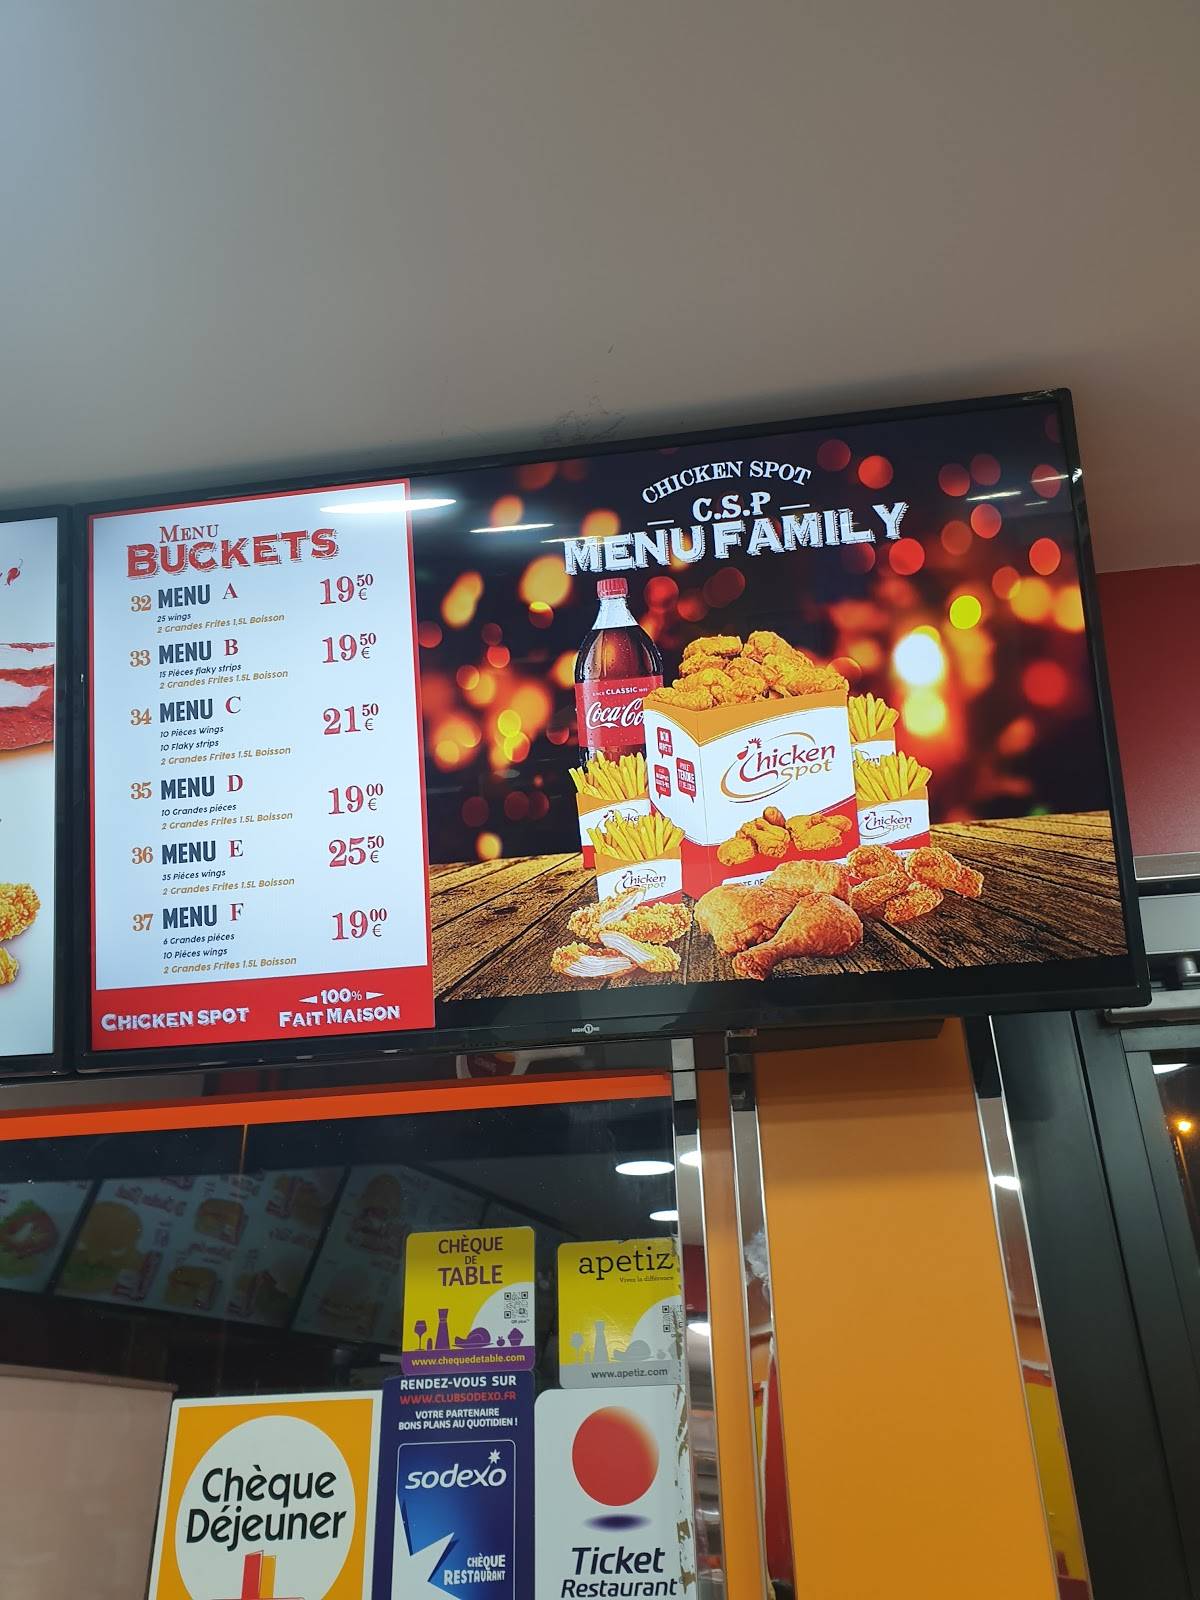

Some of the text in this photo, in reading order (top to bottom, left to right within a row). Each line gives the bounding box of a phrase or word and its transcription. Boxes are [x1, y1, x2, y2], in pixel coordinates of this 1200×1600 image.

[641, 460, 812, 504] CHICKEN SPOT
[692, 491, 771, 522] C.S.P
[563, 501, 909, 576] MENU FAMILY
[126, 528, 339, 580] BUCKETS
[131, 582, 238, 612] 32 MENU A
[156, 613, 191, 623] 25 wings
[165, 622, 203, 633] Grandes
[205, 618, 230, 628] Frites
[250, 614, 285, 624] Boisson
[130, 638, 239, 667] 33 MENU B
[168, 678, 206, 689] Grandes
[208, 674, 233, 685] Frites
[253, 670, 288, 681] Boisson
[194, 665, 216, 677] flaky
[218, 663, 242, 674] strips
[606, 687, 638, 695] CLASSIC
[130, 696, 241, 726] 34 MENU C
[586, 698, 645, 729] Coca-Co
[160, 730, 169, 738] 10
[160, 739, 219, 752] 10 Flaky strips
[168, 754, 207, 765] Grandes
[209, 751, 235, 761] Frites
[255, 746, 291, 757] Boisson
[737, 738, 836, 782] Chicken
[130, 774, 243, 800] 35 MENU D
[161, 809, 170, 817] 10
[172, 805, 208, 816] Grandes
[169, 819, 209, 829] Grandes
[210, 815, 237, 826] Frites
[257, 811, 293, 822] Boisson
[132, 839, 244, 865] 36 MENU E
[162, 873, 171, 881] 35
[201, 868, 226, 879] wings
[170, 884, 210, 895] Grandes
[212, 881, 239, 891] Frites
[259, 876, 295, 887] Boisson
[132, 902, 244, 932] 37 MENU F
[170, 934, 206, 945] Grandes
[202, 947, 228, 957] wings
[171, 963, 211, 974] Grandes
[213, 960, 240, 971] Frites
[260, 956, 297, 967] Boisson
[321, 988, 363, 1005] 100%
[100, 1007, 250, 1032] CHICKEN SPOT
[279, 1005, 400, 1028] FAIT MAISON
[437, 1236, 504, 1254] CHÈQUE
[464, 1255, 478, 1265] DE
[578, 1246, 674, 1280] apetiz
[438, 1265, 503, 1286] TABLE
[411, 1353, 525, 1367] www.chequedetable.com
[591, 1367, 668, 1379] www.apetiz.com
[400, 1375, 517, 1391] RENDEZ-VOUS SUR
[399, 1391, 517, 1405] WWW.CLUBSODEXO.FR
[415, 1407, 500, 1419] VOTRE PARTENAIRE
[398, 1421, 421, 1431] BONS
[423, 1419, 451, 1430] PLANS
[452, 1419, 465, 1428] AU
[466, 1417, 513, 1429] QUOTIDIEN
[404, 1463, 507, 1490] sodexo
[202, 1464, 337, 1509] Chèque
[186, 1505, 347, 1552] Déjeuner
[466, 1552, 506, 1570] CHÈQUE
[571, 1546, 666, 1576] Ticket
[443, 1569, 506, 1586] RESTAURANT
[560, 1578, 678, 1599] Restaurant
